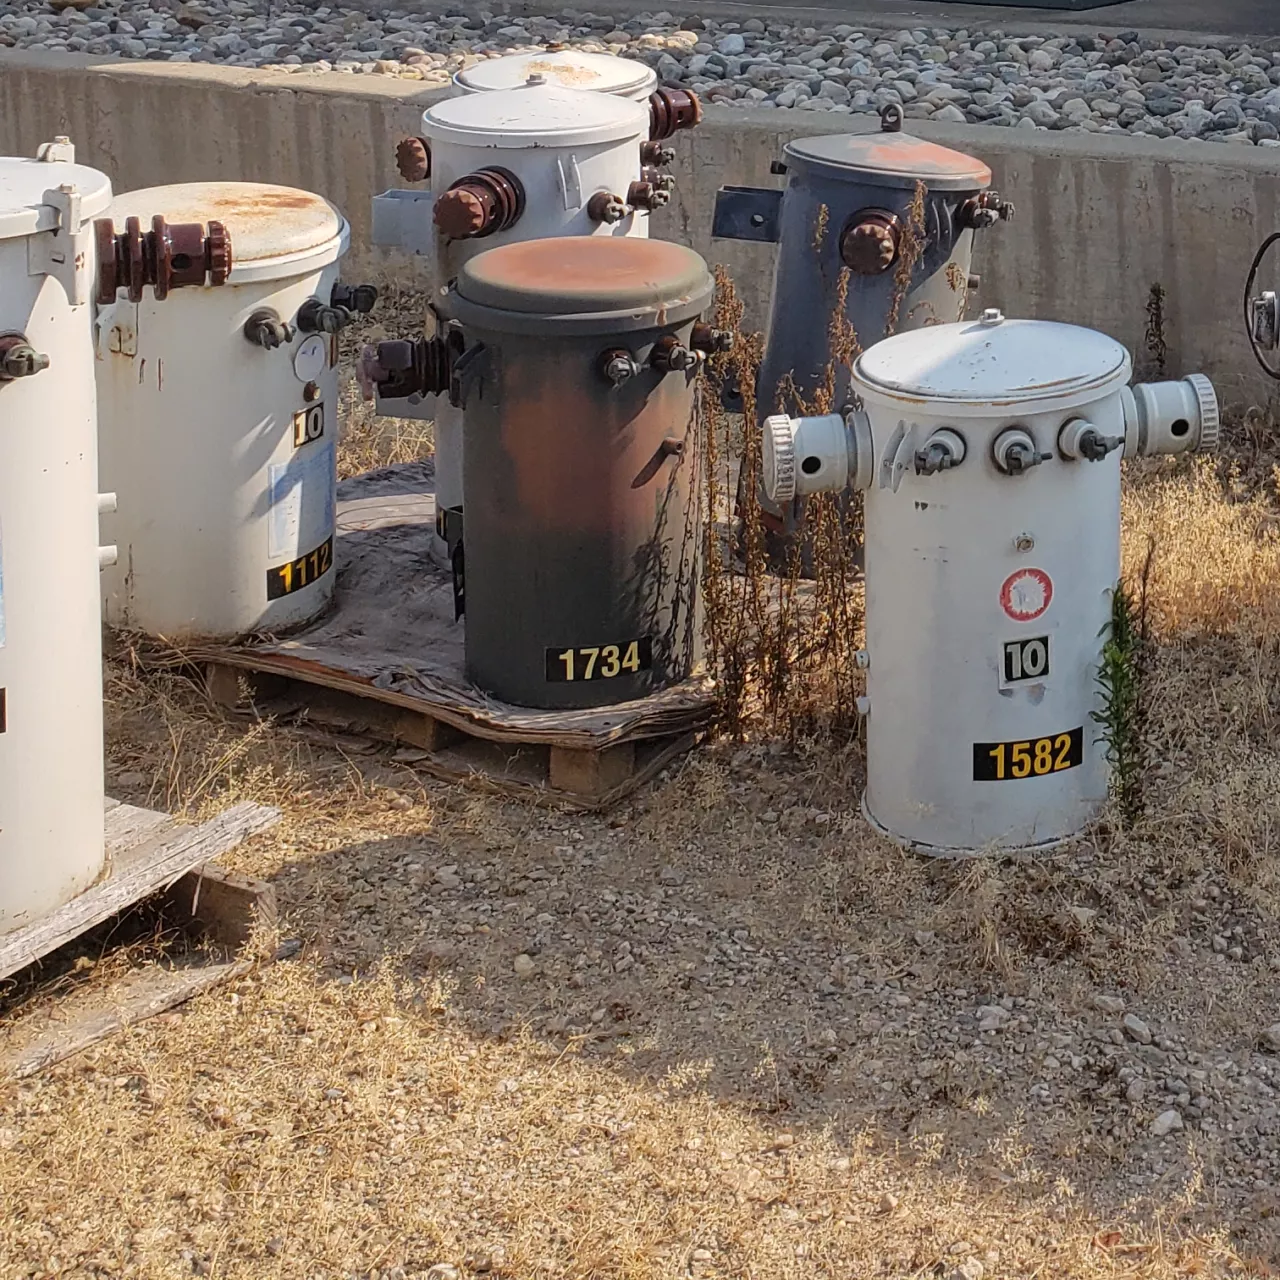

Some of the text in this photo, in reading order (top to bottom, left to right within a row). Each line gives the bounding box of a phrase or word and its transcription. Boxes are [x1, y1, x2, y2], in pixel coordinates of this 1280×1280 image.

[294, 407, 324, 446] 10
[279, 543, 330, 593] 1112
[558, 640, 641, 681] 1734
[1006, 639, 1047, 679] 10
[989, 733, 1072, 779] 1582
